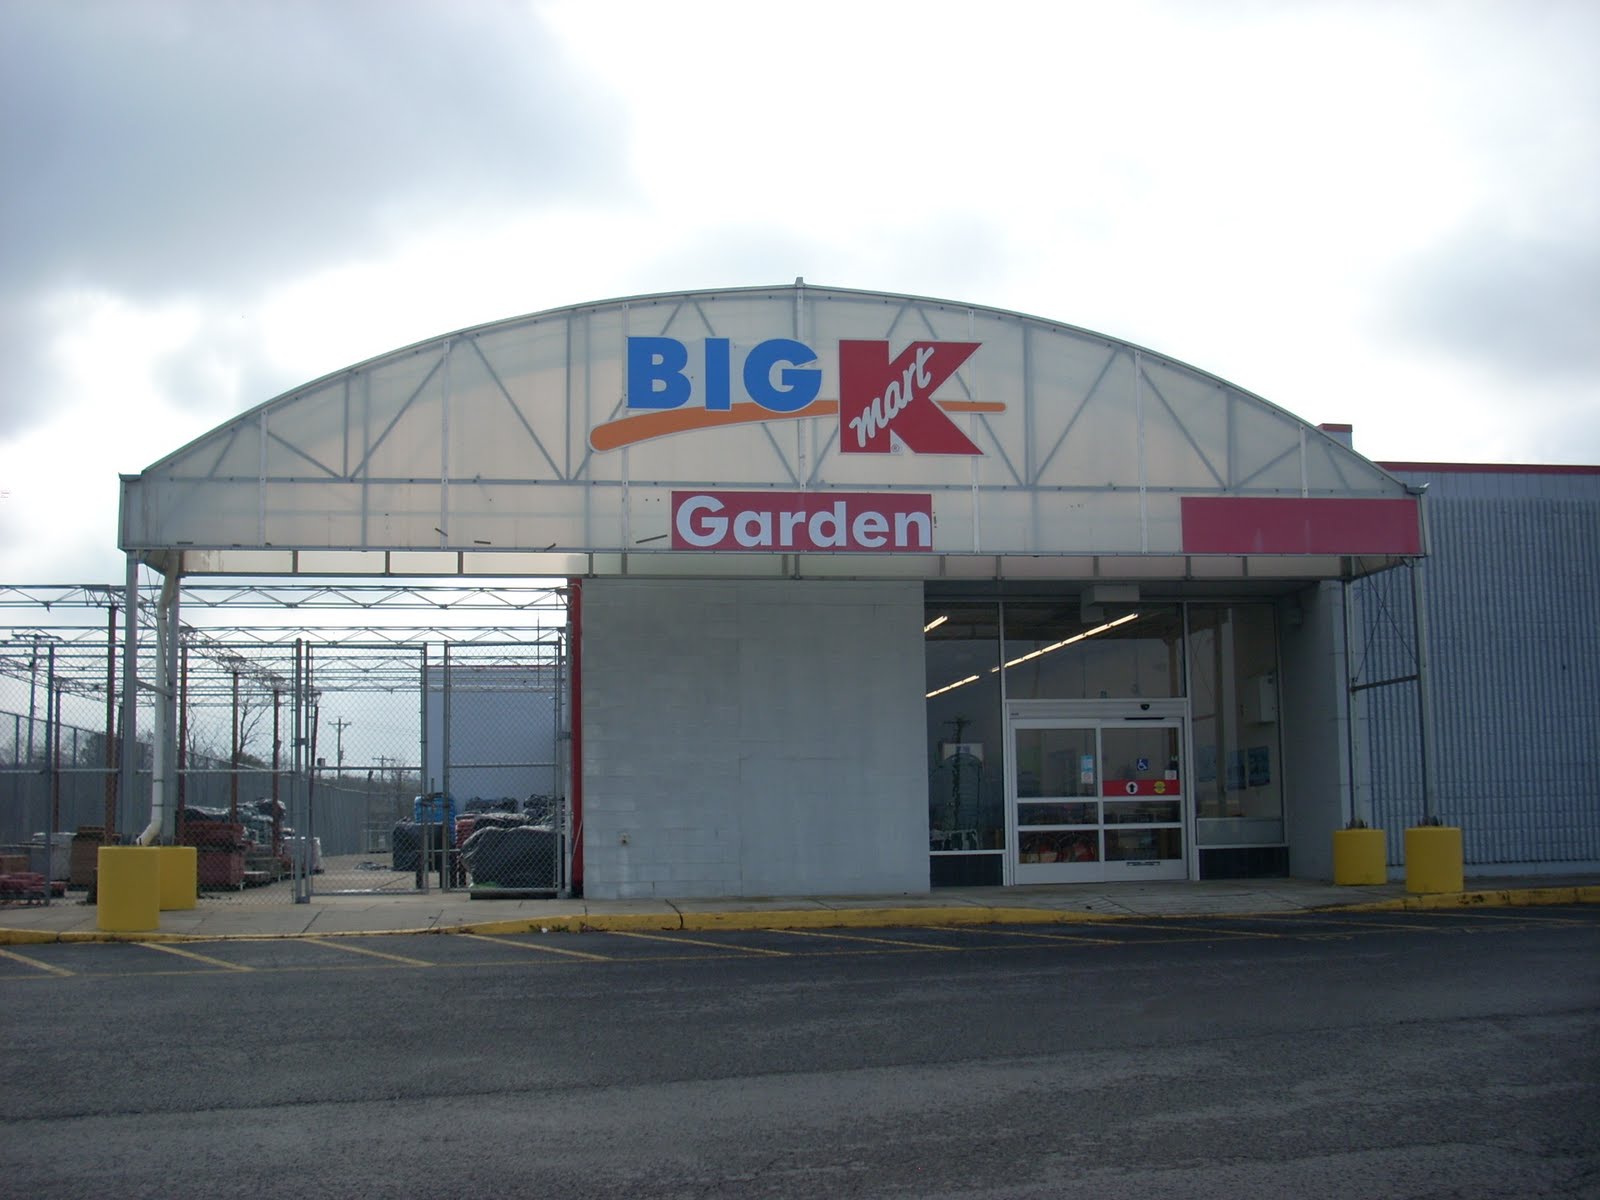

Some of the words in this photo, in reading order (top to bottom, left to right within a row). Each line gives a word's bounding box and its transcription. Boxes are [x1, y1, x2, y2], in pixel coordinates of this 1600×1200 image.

[627, 337, 822, 412] BIG
[839, 340, 984, 454] K
[849, 347, 934, 447] mart
[676, 495, 932, 547] Garden
